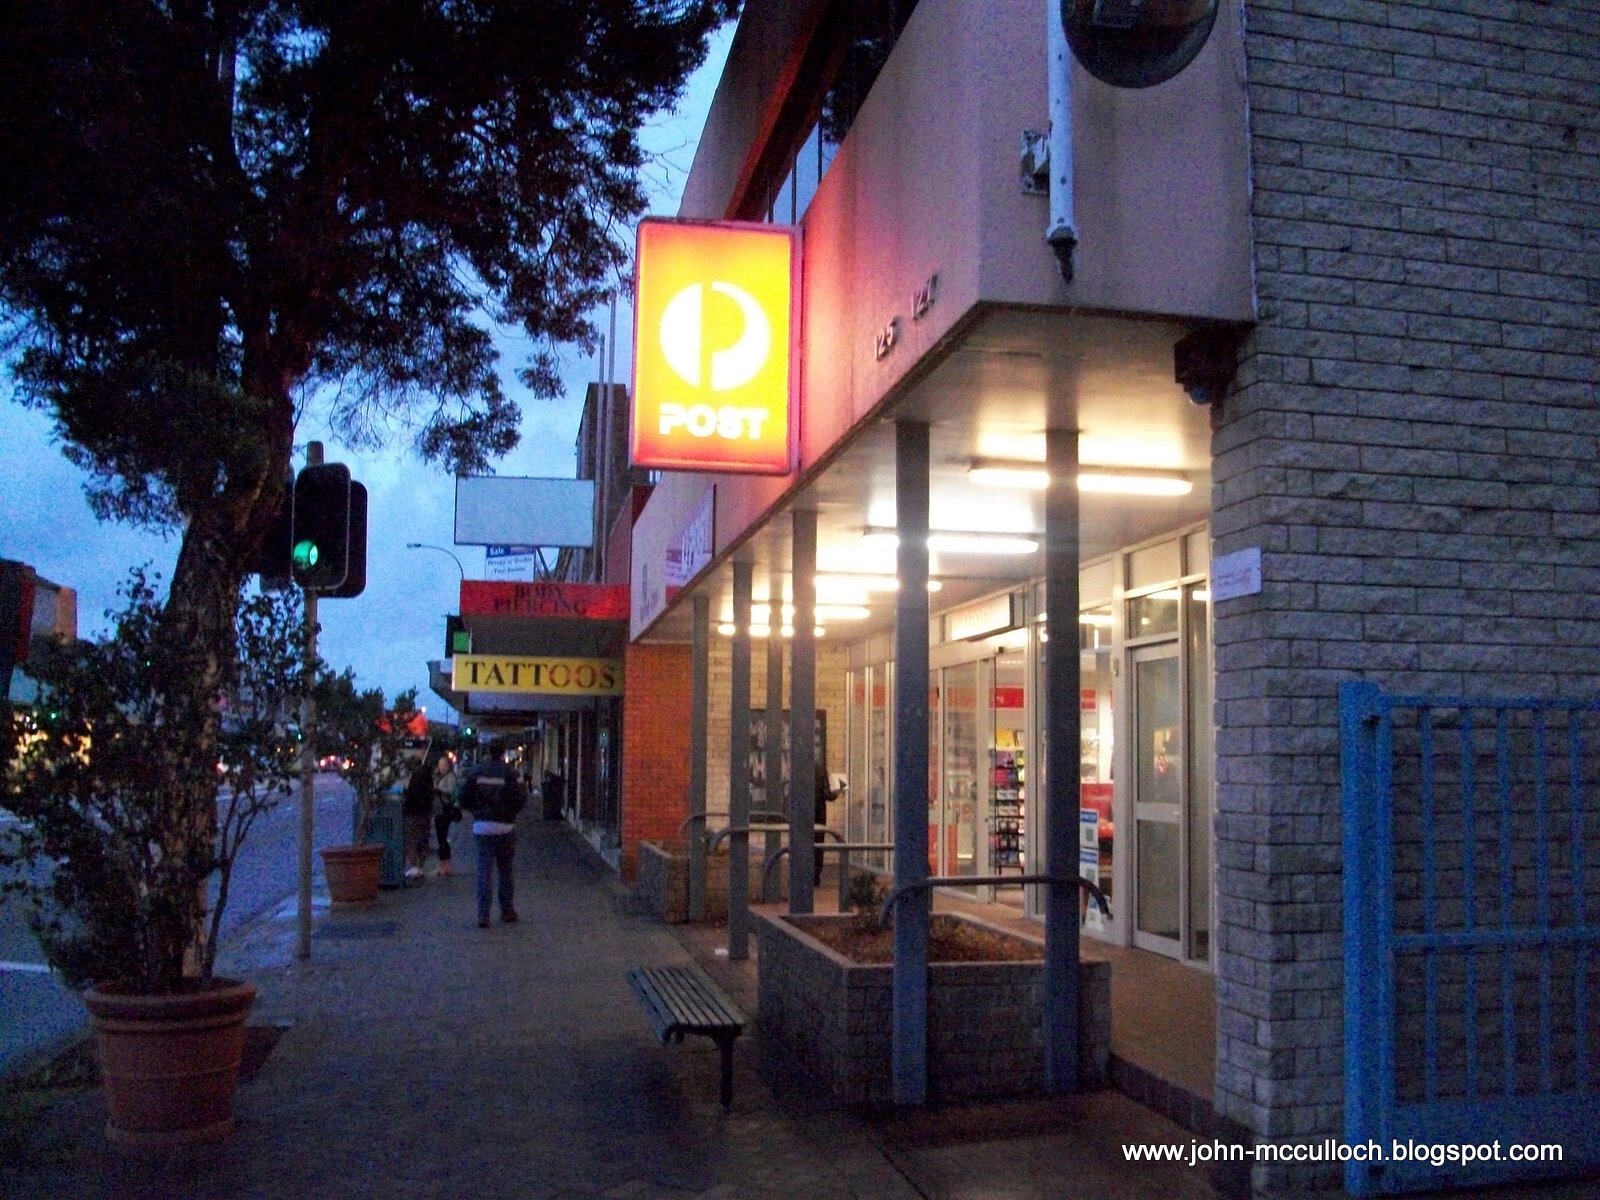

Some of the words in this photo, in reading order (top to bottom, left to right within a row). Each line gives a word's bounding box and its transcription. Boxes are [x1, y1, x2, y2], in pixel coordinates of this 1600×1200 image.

[874, 317, 898, 361] 125
[658, 402, 769, 440] POST
[465, 661, 615, 689] TATTOOS
